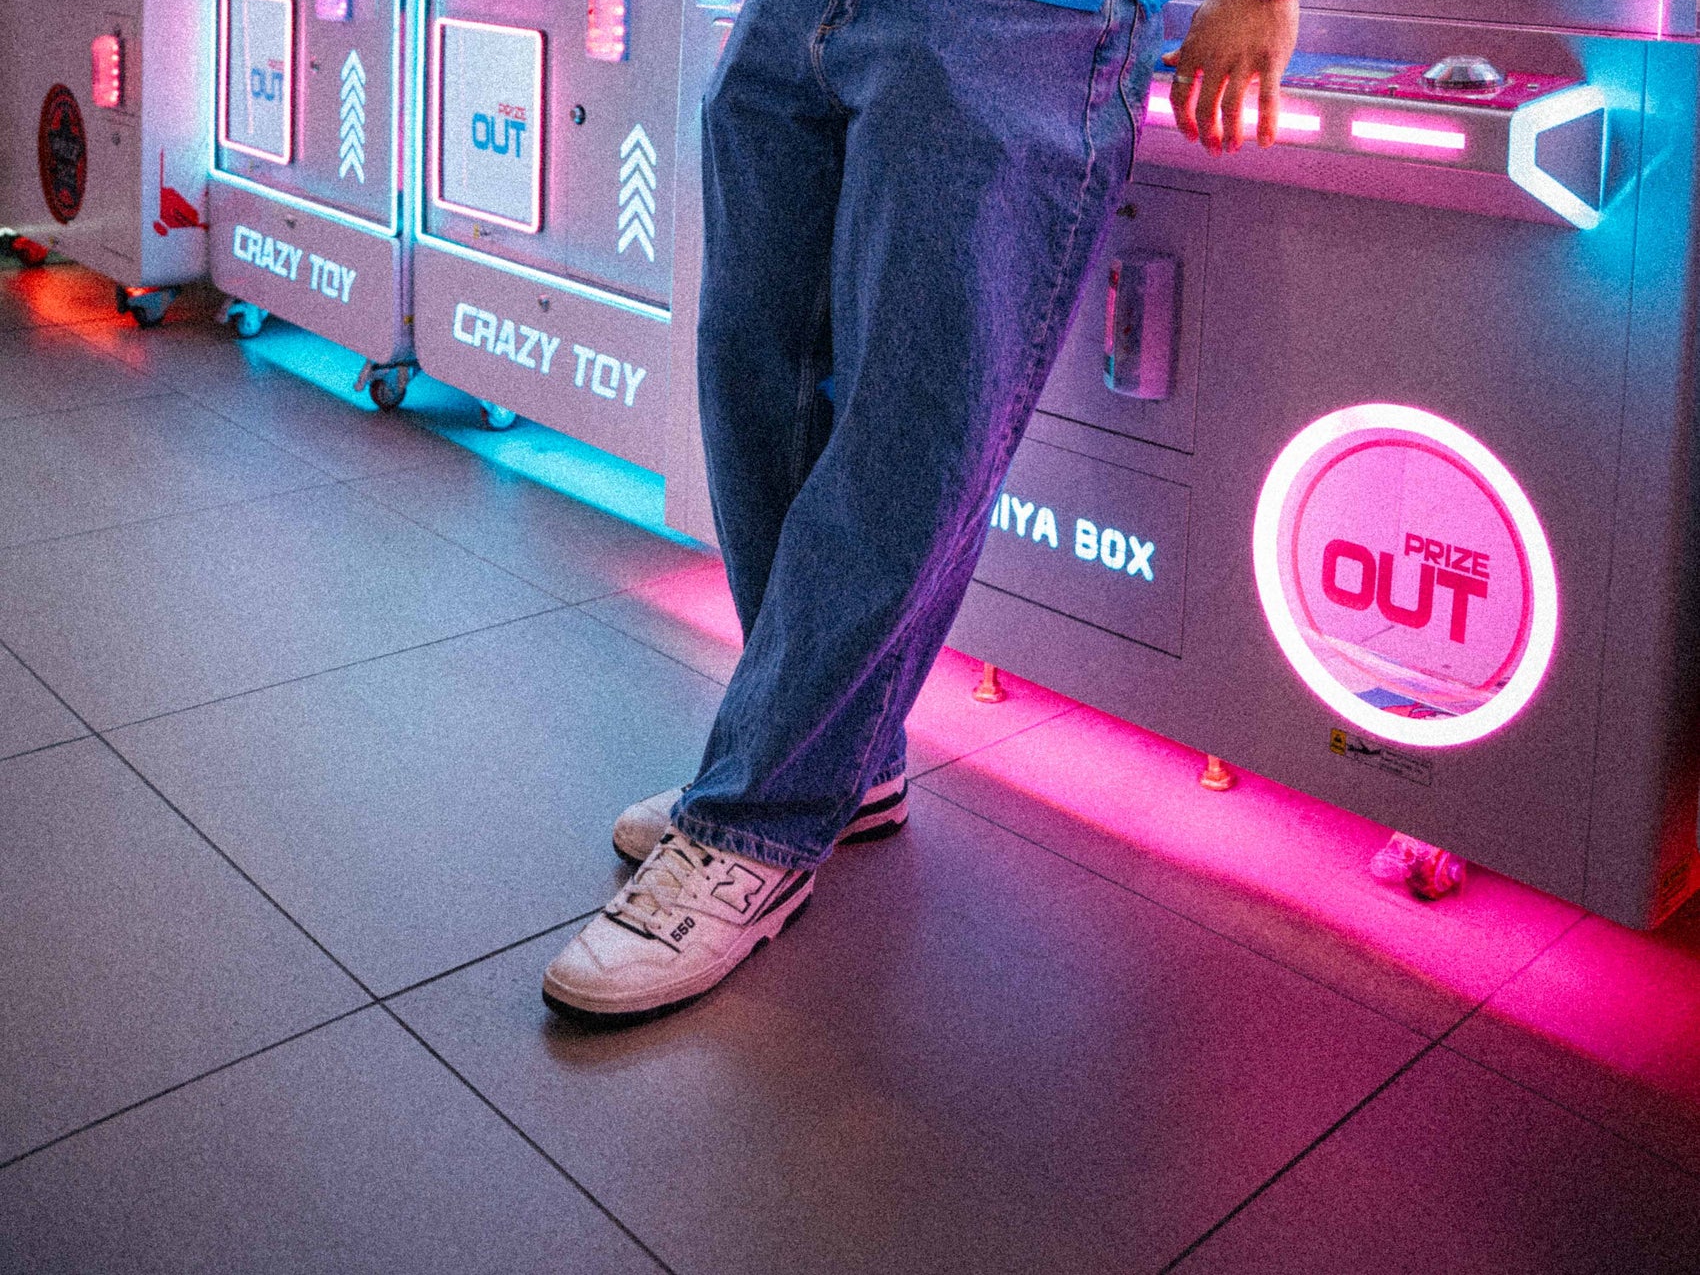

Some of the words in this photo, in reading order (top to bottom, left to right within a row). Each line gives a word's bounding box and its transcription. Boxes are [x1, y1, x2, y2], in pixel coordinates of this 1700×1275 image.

[472, 111, 527, 159] OUT
[232, 224, 304, 282] CRAZY
[309, 253, 357, 304] TOY
[453, 302, 561, 375] CRAZY
[573, 344, 647, 418] TOY
[990, 492, 1059, 549] IYA
[1074, 517, 1156, 583] BOX
[1404, 532, 1490, 580] PRIZE
[1322, 538, 1488, 645] OUT
[669, 916, 696, 942] 550
